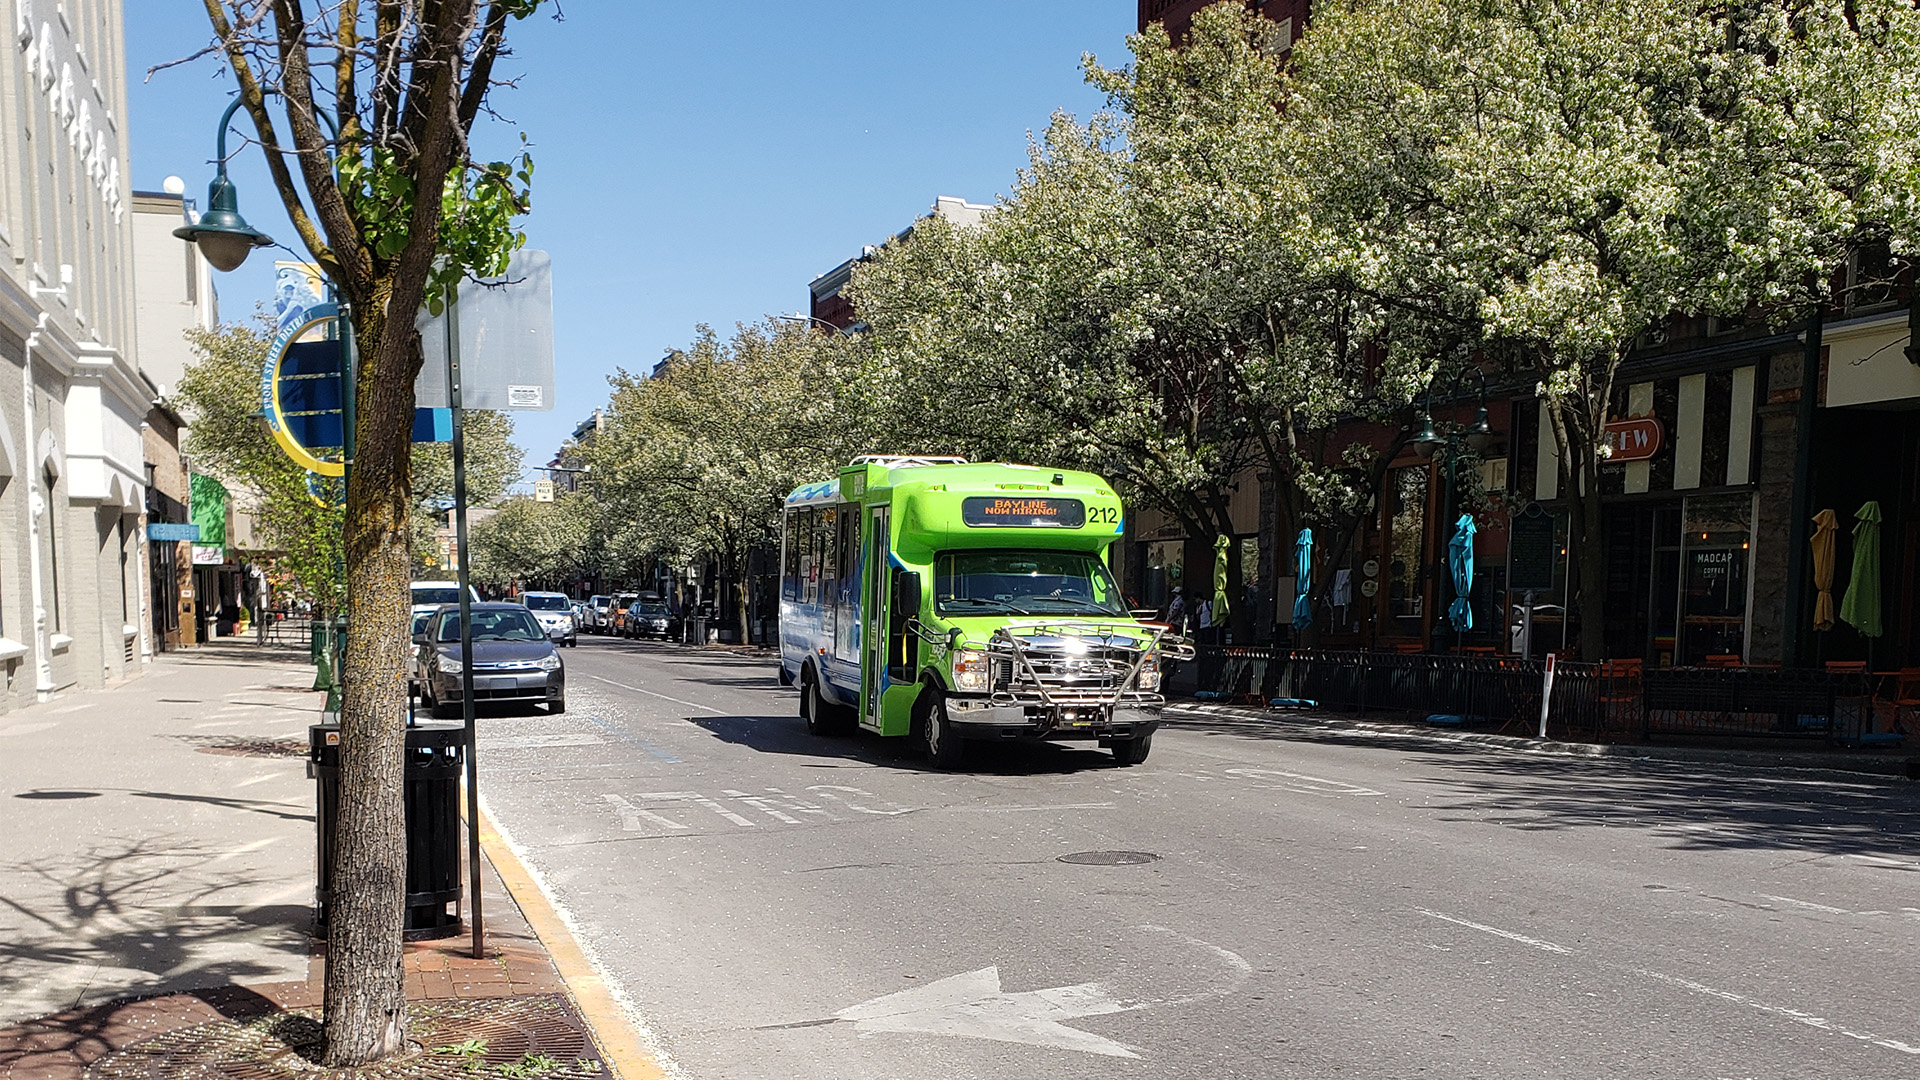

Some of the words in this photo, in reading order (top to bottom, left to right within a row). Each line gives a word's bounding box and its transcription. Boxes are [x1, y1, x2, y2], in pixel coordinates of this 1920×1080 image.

[279, 310, 313, 342] DISTRICT
[264, 341, 282, 375] STREET
[263, 377, 274, 409] FRONT
[985, 507, 1010, 515] NOW
[1012, 507, 1057, 516] HIRING!
[995, 500, 1047, 509] BAYLINE
[1088, 507, 1118, 524] 212
[1697, 553, 1733, 563] MADCAP
